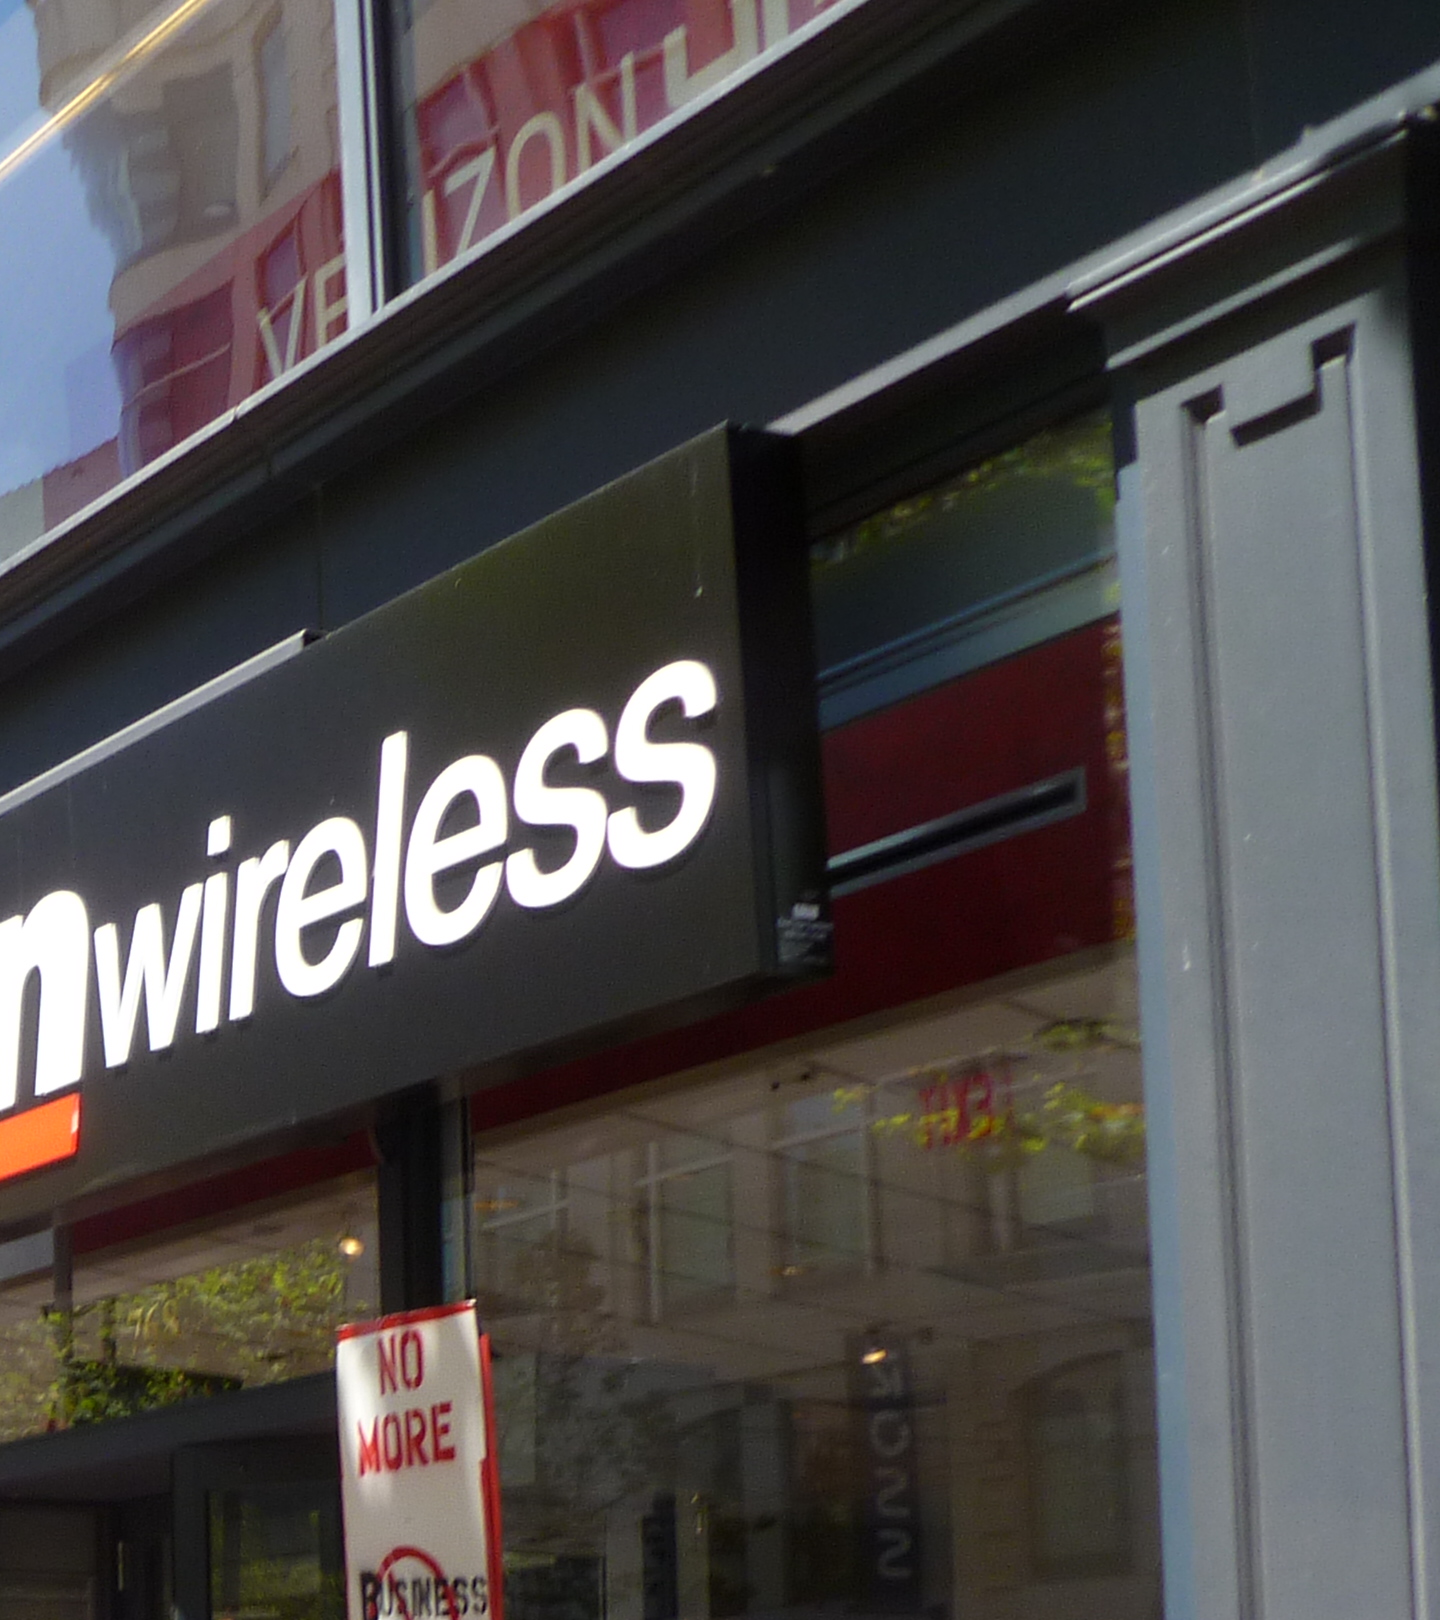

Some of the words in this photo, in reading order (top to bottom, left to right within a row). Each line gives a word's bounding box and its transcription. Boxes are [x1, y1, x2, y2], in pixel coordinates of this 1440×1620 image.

[95, 659, 718, 1069] wireless
[378, 1328, 424, 1396] NO
[357, 1401, 456, 1476] MORE
